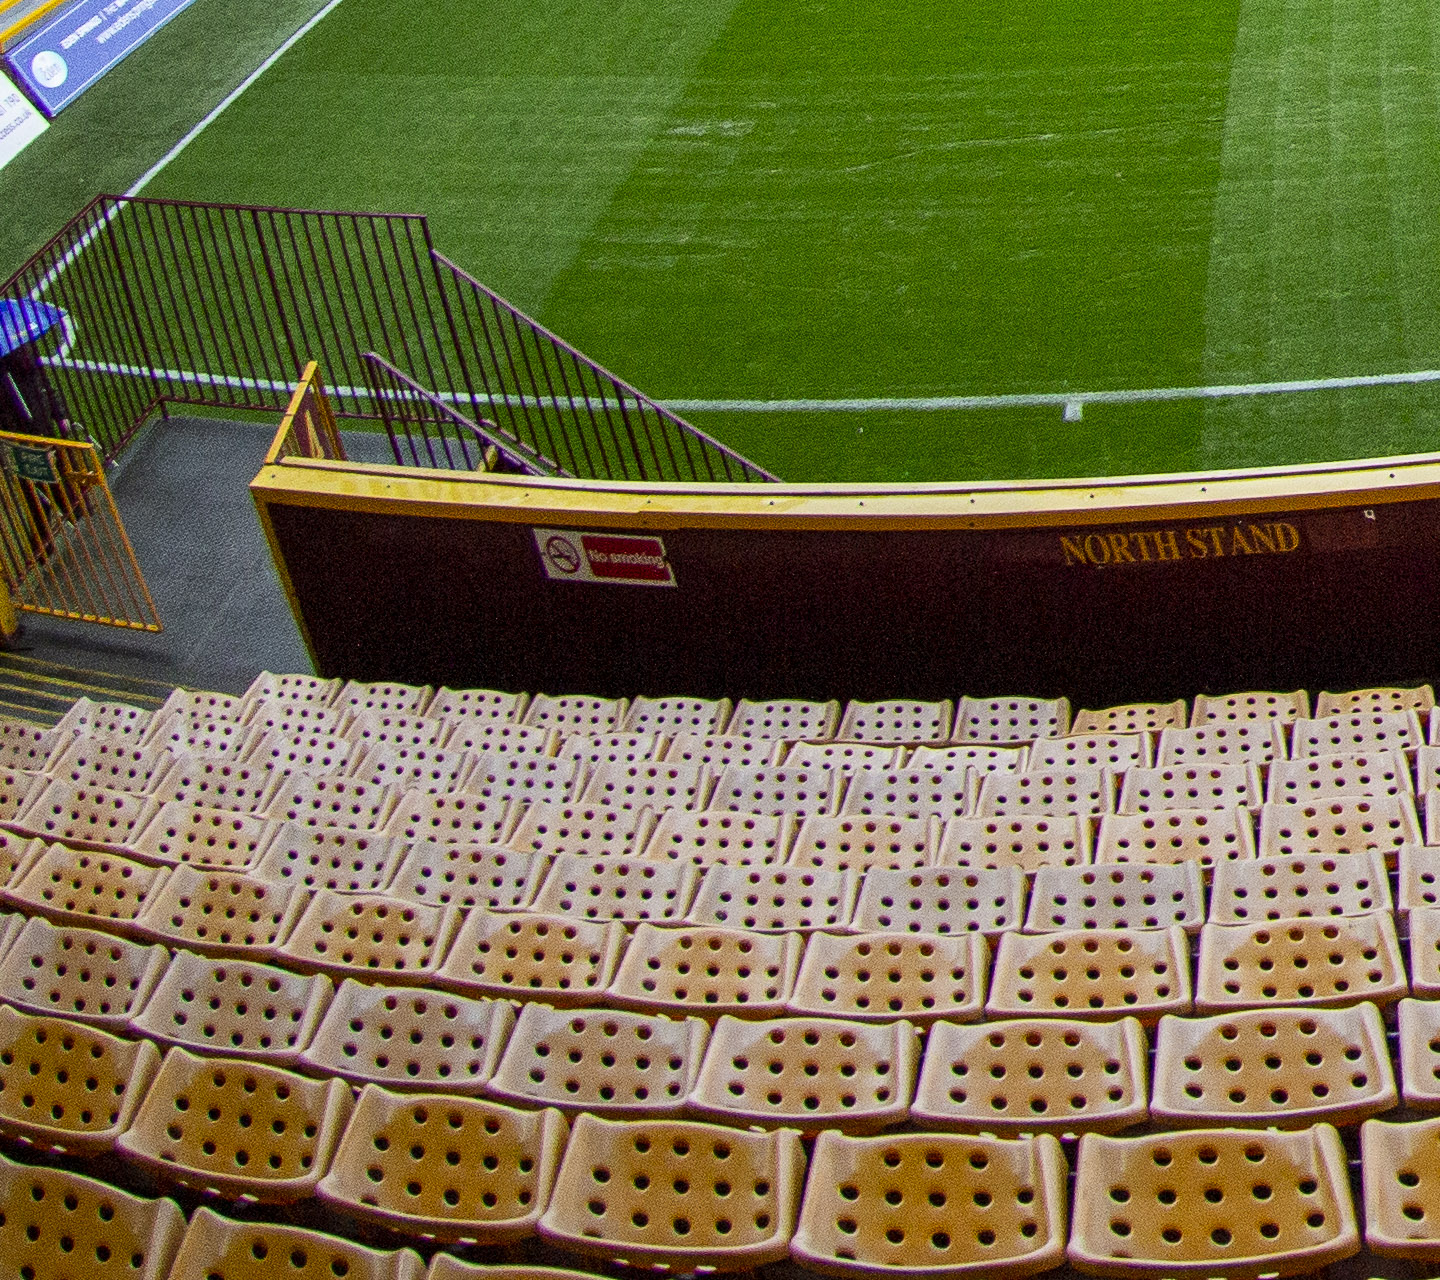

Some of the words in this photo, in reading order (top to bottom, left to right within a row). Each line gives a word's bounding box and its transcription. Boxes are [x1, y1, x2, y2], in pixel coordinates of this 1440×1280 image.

[1059, 530, 1182, 567] NORTH
[1186, 521, 1299, 559] STAND
[609, 552, 666, 569] smoking
